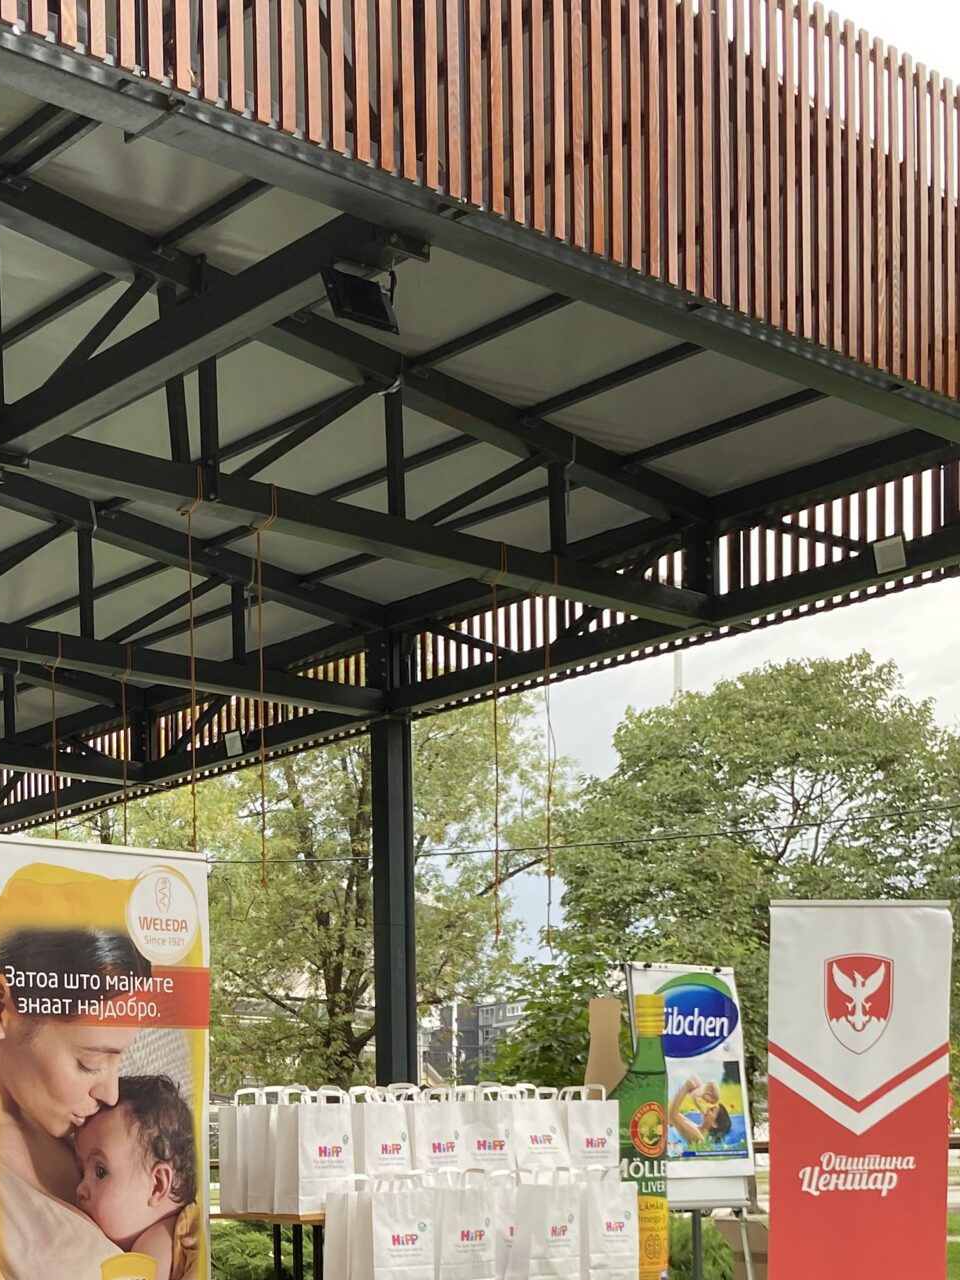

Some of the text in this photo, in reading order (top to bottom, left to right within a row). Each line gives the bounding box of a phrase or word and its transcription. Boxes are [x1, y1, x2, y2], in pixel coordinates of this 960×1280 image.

[139, 916, 188, 933] WELEDA
[144, 935, 185, 947] Since 1921
[5, 965, 174, 996] Затоа што мајките
[18, 996, 161, 1020] знаат најдобро.
[662, 1006, 729, 1038] übchen
